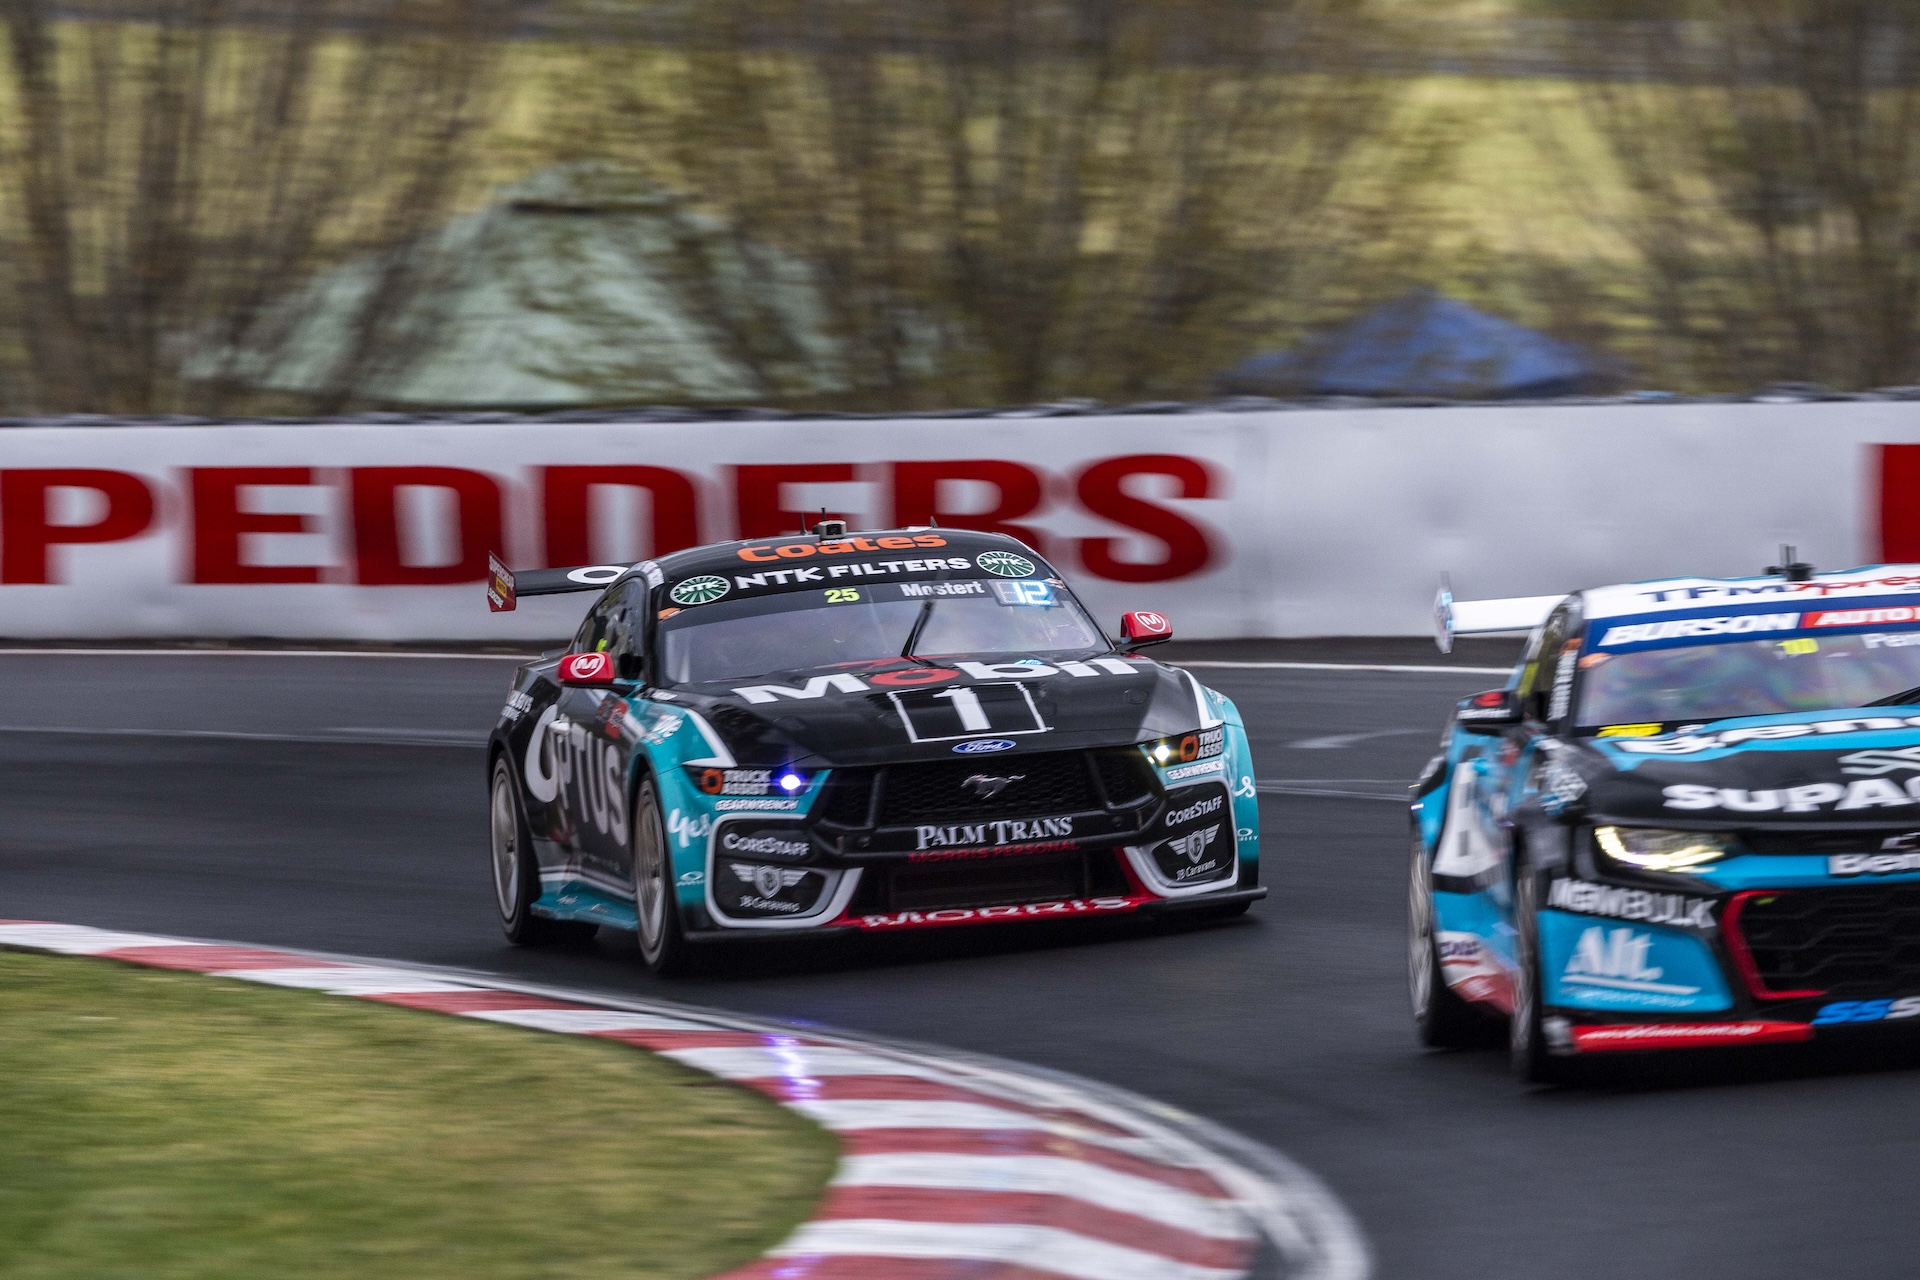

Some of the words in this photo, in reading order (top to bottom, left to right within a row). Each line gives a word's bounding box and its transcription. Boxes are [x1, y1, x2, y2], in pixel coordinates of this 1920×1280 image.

[0, 453, 1224, 585] PEDDERS
[734, 567, 825, 590] NTK
[827, 556, 972, 579] FILTERS
[983, 556, 1024, 567] NTK
[678, 580, 721, 595] NTK
[824, 588, 861, 604] 25
[900, 581, 985, 597] Mostert
[1598, 612, 1802, 647] BURSON
[731, 658, 1139, 704] Mobil
[932, 685, 992, 732] 1
[524, 704, 628, 847] OPTUS
[723, 770, 772, 782] TRUCK
[1661, 777, 1920, 813] SUPA
[914, 824, 987, 850] PALM
[989, 816, 1074, 845] TRANS
